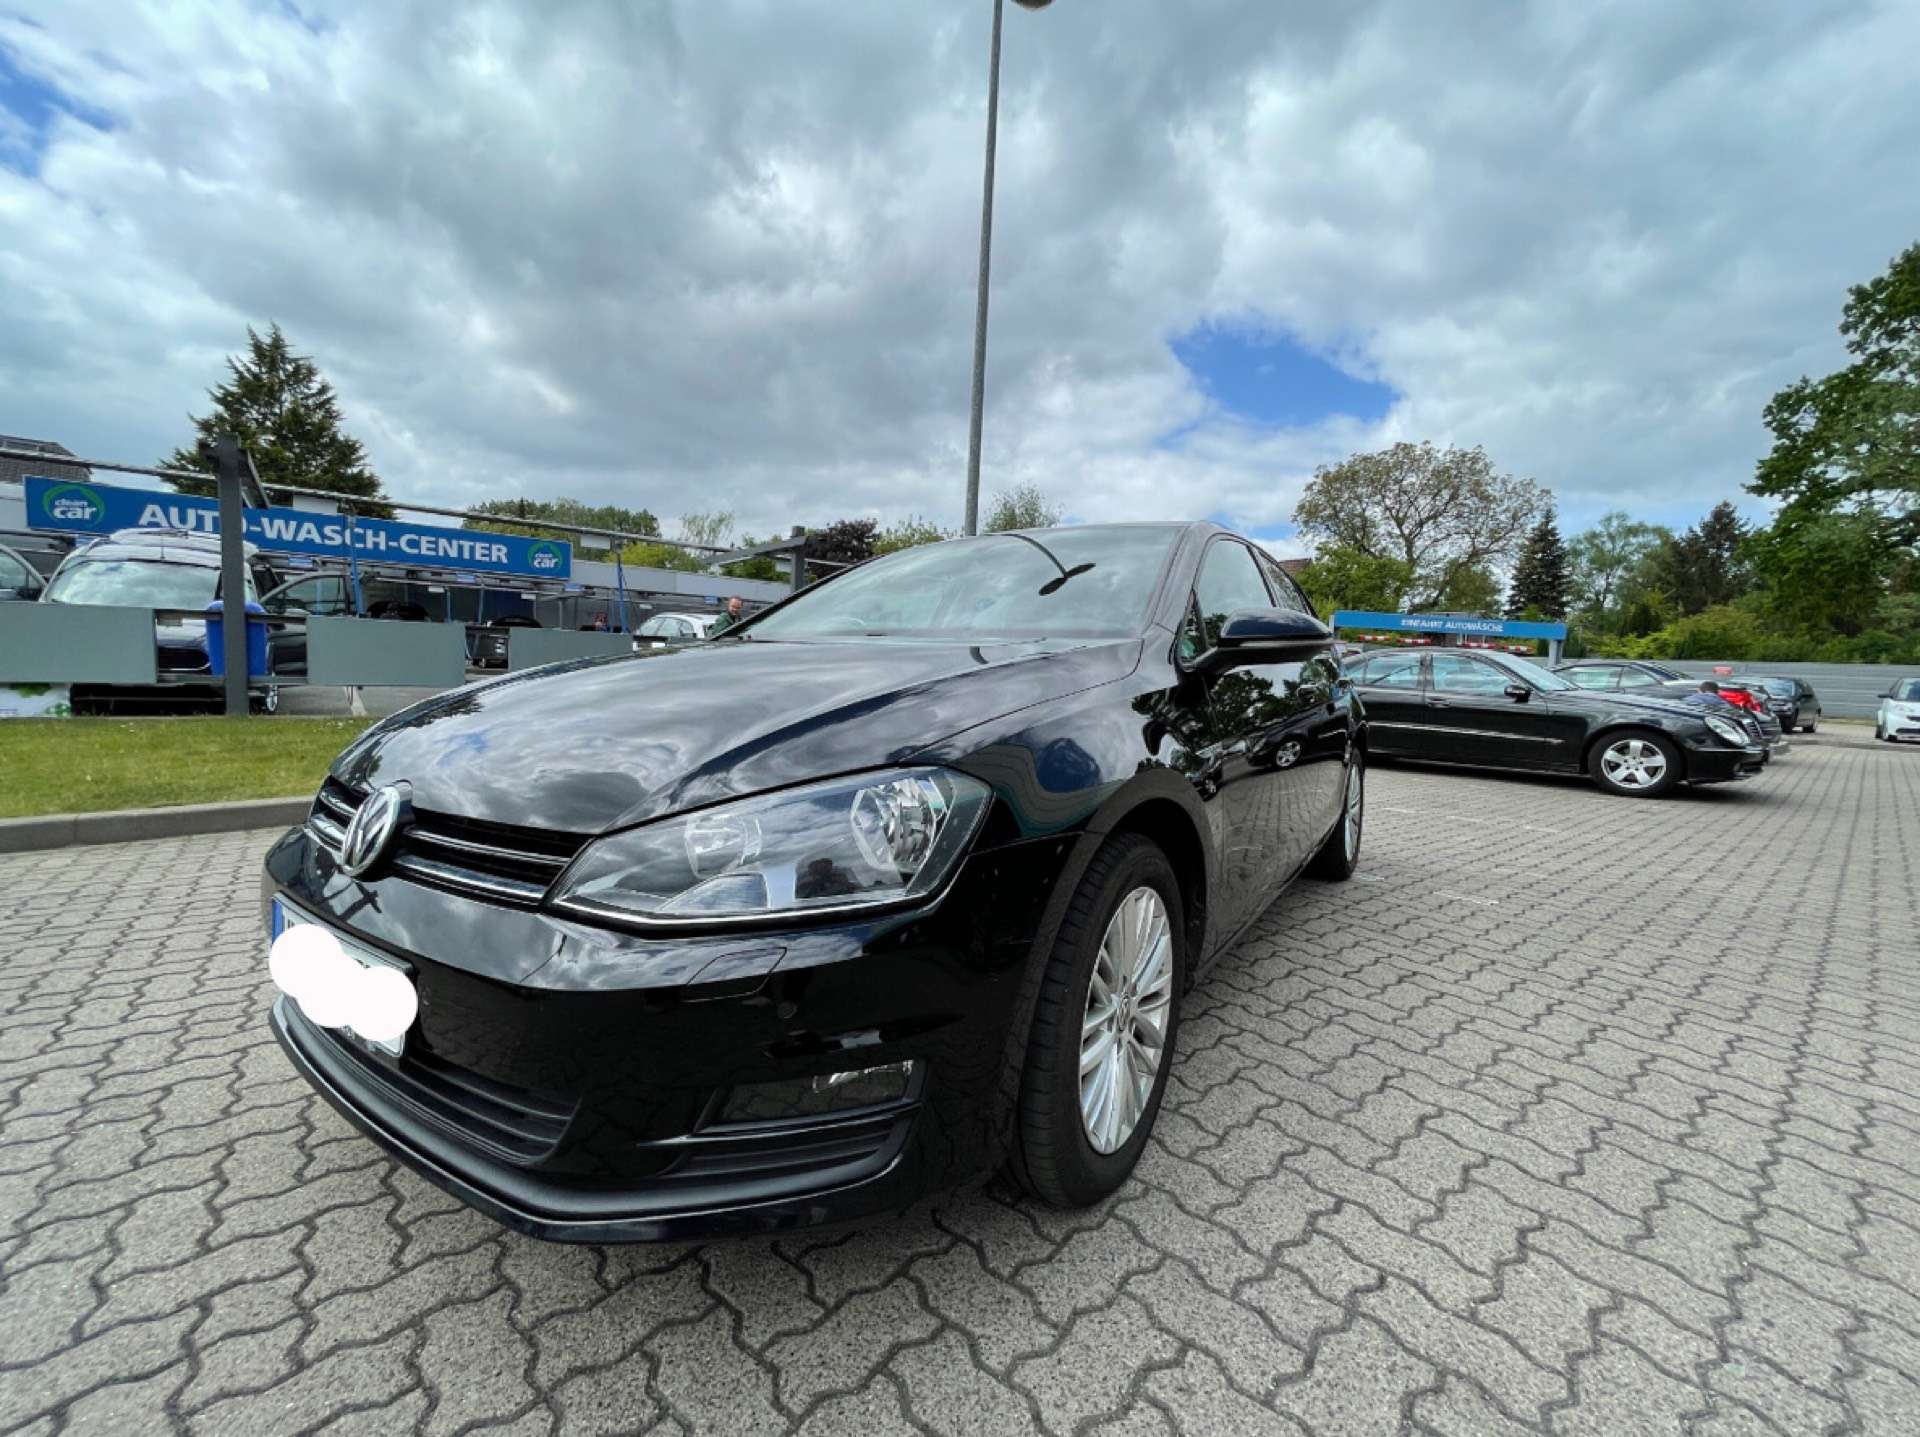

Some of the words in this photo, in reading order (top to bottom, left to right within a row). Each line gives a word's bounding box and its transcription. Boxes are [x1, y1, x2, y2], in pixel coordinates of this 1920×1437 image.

[53, 507, 97, 520] car
[138, 504, 508, 564] AUT-WASCH-CENTER
[533, 558, 559, 568] car
